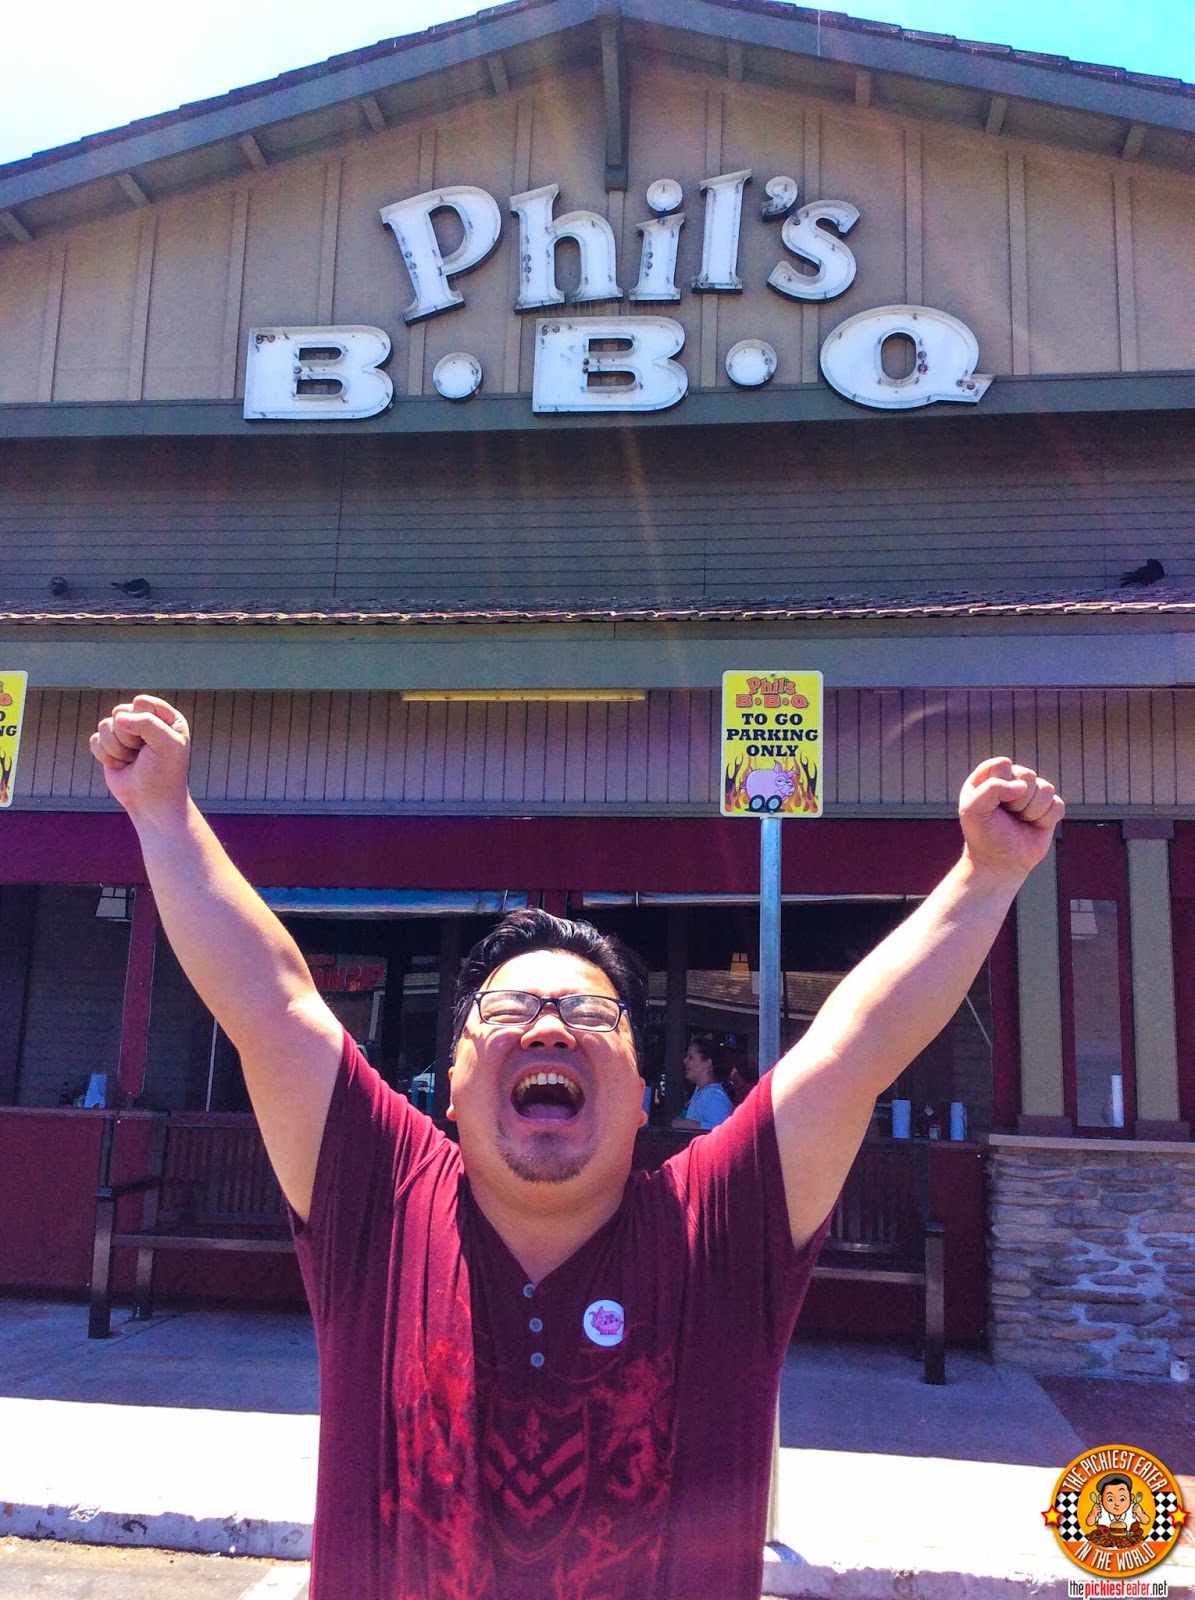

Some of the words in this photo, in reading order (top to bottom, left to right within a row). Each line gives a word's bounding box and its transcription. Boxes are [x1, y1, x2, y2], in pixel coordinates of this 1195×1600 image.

[378, 168, 857, 325] Phil's
[746, 677, 796, 695] Phil's
[741, 713, 768, 725] TO
[775, 713, 803, 725] GO
[726, 729, 818, 741] PARKING
[746, 745, 799, 757] ONLY
